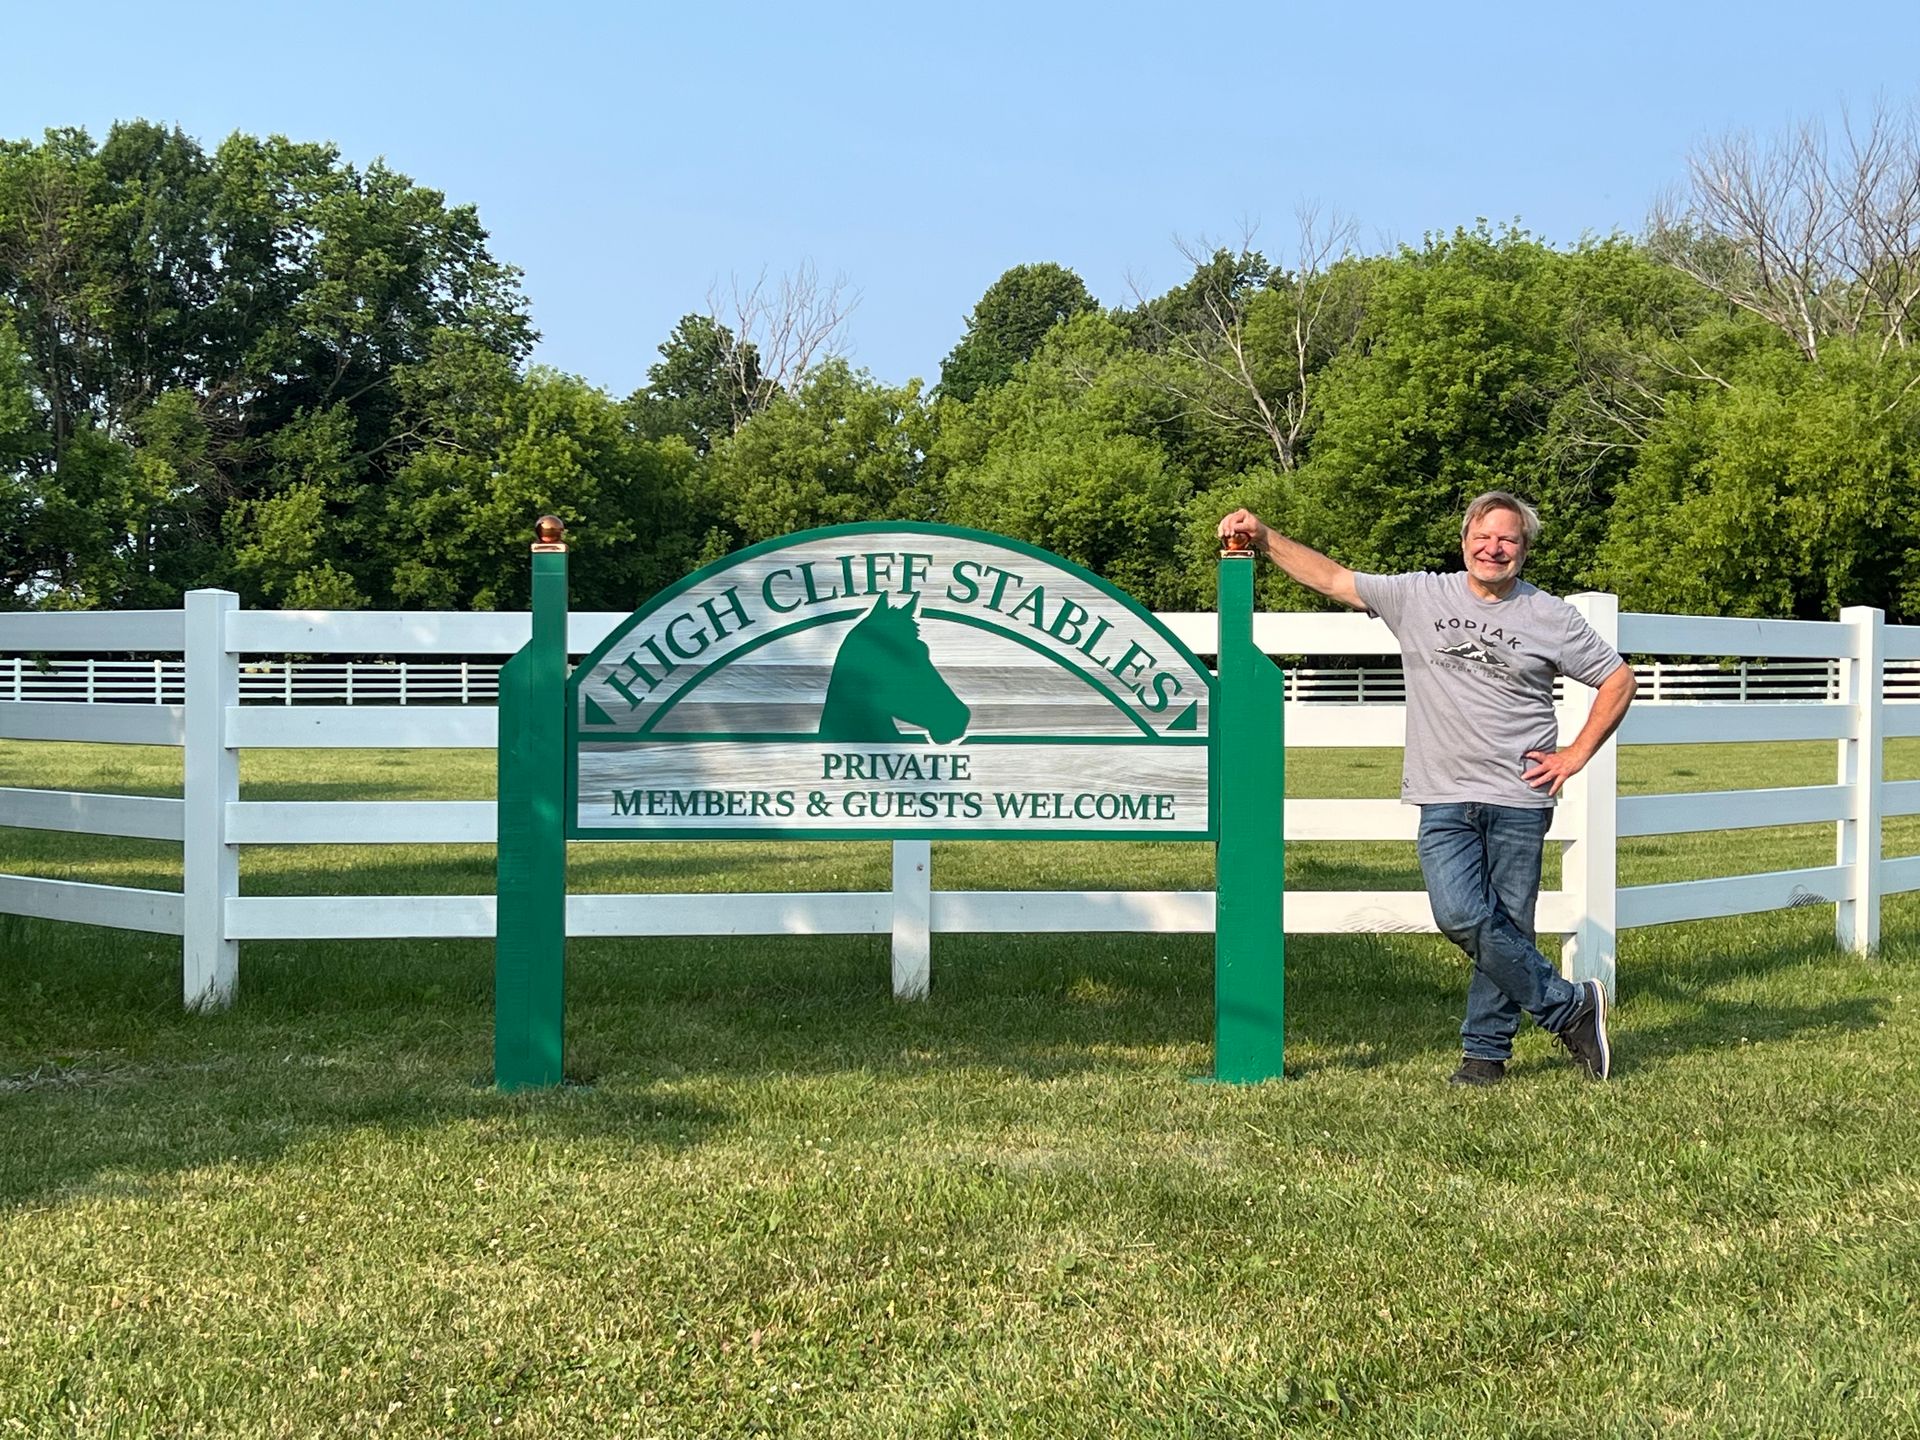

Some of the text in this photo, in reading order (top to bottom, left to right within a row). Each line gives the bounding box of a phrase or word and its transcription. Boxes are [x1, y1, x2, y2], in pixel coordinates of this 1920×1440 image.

[602, 552, 1183, 713] HIGH CLIFF STABLES
[1434, 618, 1521, 650] KODIAK
[821, 753, 971, 780] PRIVATE
[611, 789, 1176, 820] MEMBERS & GUESTS WELCOME
